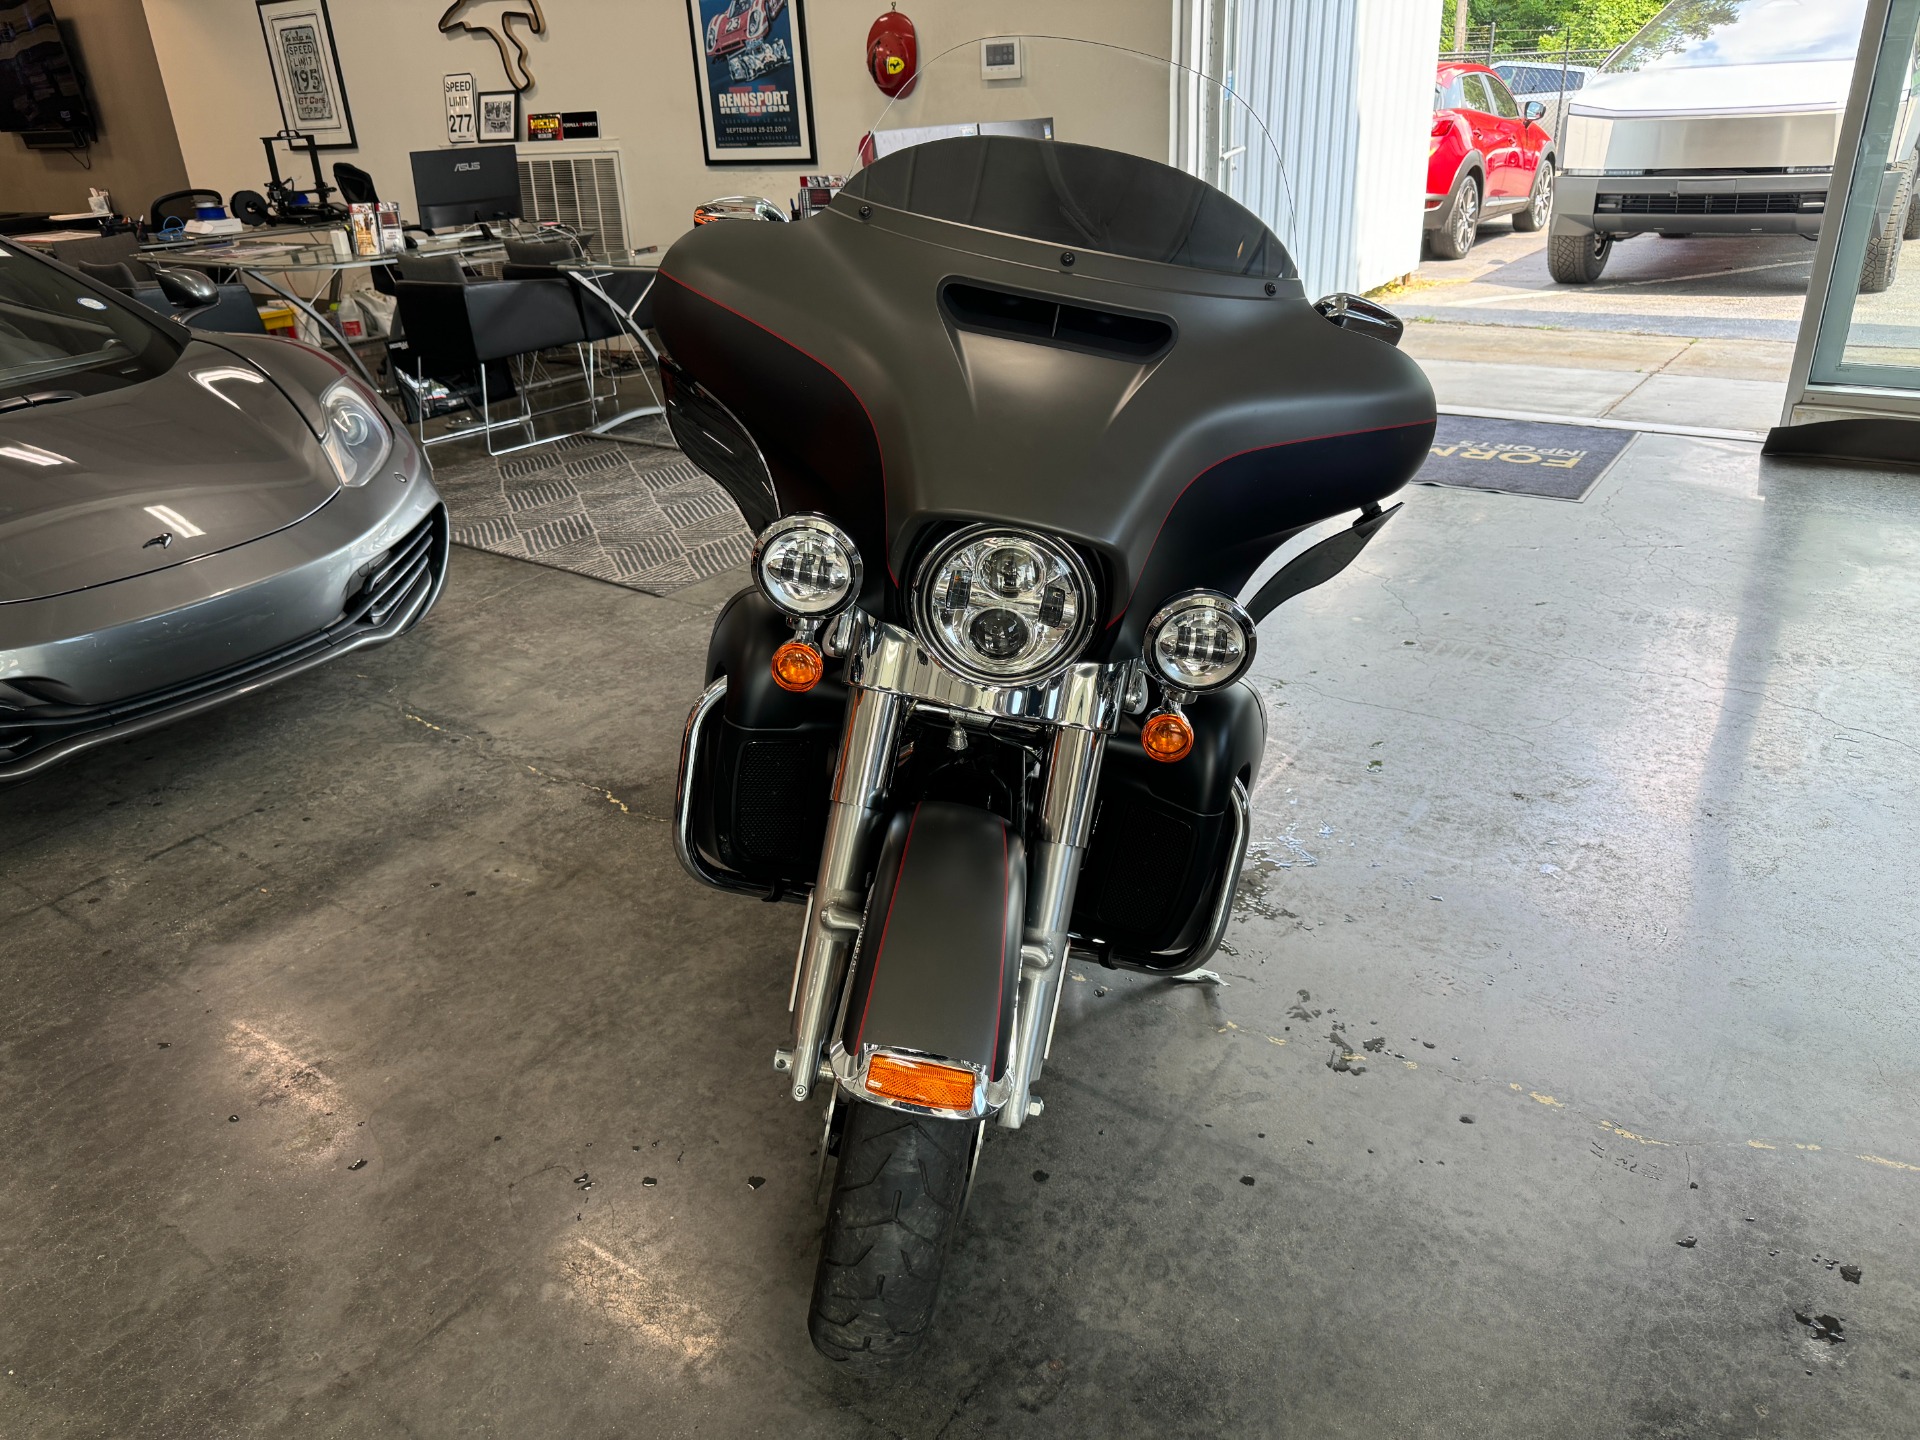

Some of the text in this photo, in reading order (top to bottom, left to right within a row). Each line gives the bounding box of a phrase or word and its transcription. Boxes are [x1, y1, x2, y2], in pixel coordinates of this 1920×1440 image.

[725, 17, 740, 33] 23
[289, 45, 313, 55] SPEED
[293, 57, 313, 67] LIMIT
[294, 69, 320, 92] 195
[445, 81, 471, 92] SPEED
[298, 97, 309, 105] GT
[449, 96, 468, 107] LIMIT
[718, 90, 789, 107] RENNSPORT
[720, 105, 790, 114] REUNION
[449, 114, 472, 133] 277
[454, 162, 480, 172] ASUS
[1458, 439, 1588, 459] IMPORTS
[1429, 446, 1581, 469] FORM
